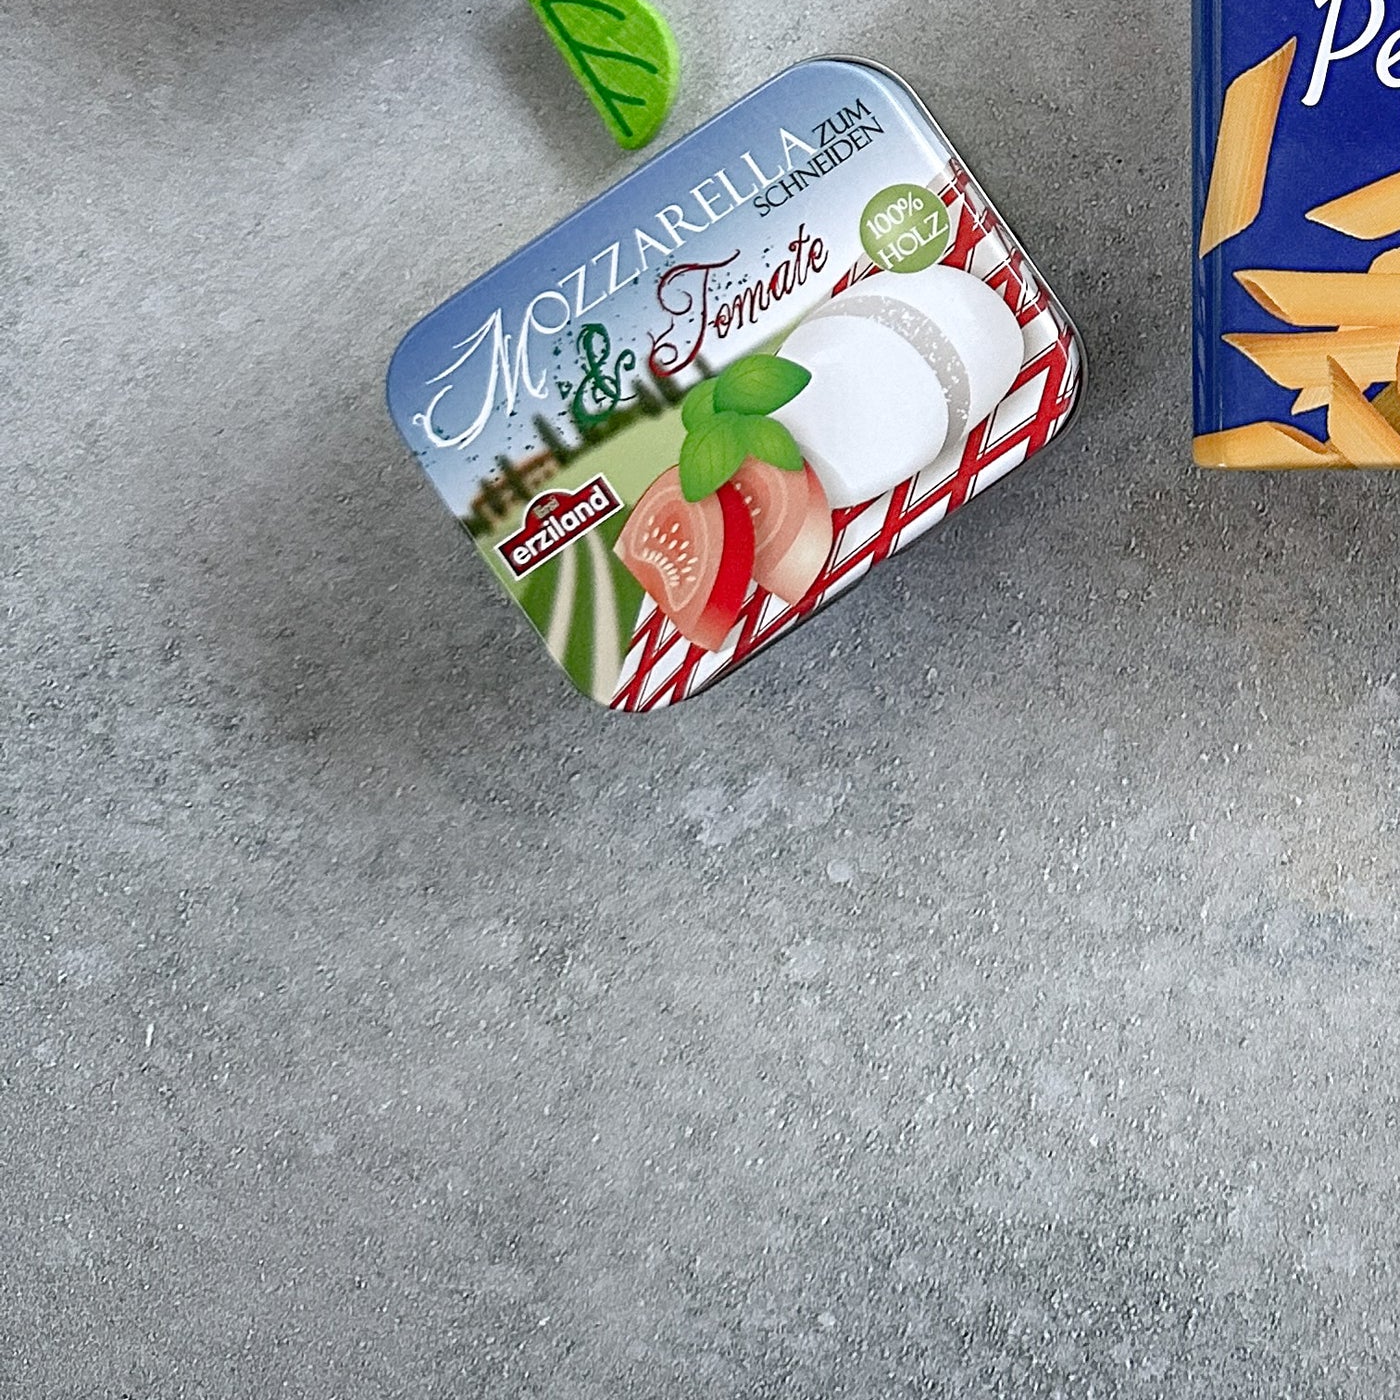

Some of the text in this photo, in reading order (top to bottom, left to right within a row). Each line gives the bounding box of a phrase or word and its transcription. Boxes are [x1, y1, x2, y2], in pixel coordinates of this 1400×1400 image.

[812, 98, 872, 148] ZUM
[753, 116, 885, 218] SCHNEIDEN
[866, 191, 924, 241] 100%
[877, 211, 949, 269] HOLZ
[412, 127, 818, 450] MOZZARELLA
[571, 223, 830, 425] & Tomate
[513, 484, 611, 565] erziland
